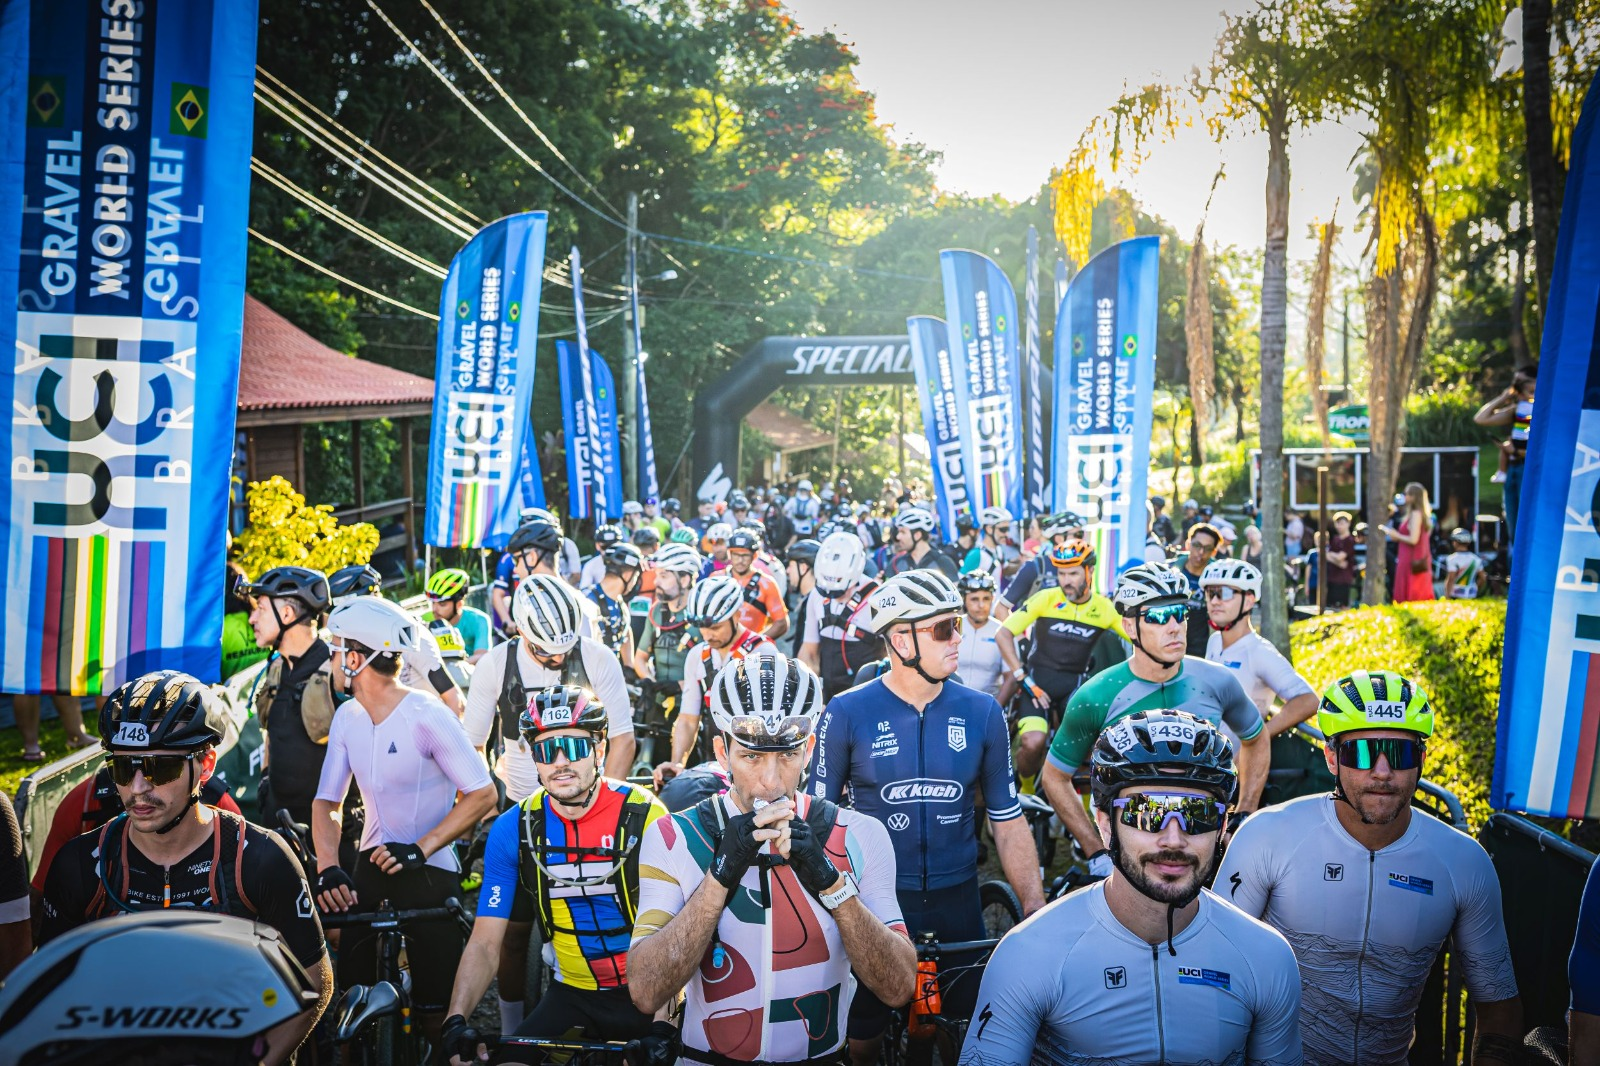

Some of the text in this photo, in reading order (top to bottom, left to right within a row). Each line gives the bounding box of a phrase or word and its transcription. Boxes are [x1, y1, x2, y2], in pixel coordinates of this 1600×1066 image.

[90, 0, 143, 300] WORLD SERIES
[40, 131, 82, 296] GRAVEL
[476, 267, 501, 388] WORLD SERIES
[459, 321, 477, 387] GRAVEL
[1095, 297, 1114, 430] WORLD SERIES
[1076, 357, 1093, 430] GRAVEL
[33, 334, 117, 526] UCI
[452, 402, 485, 478] UCI
[976, 405, 998, 470] UCI
[599, 411, 614, 474] BRASIL
[944, 448, 968, 506] UCI
[881, 596, 897, 608] 242
[1122, 589, 1137, 599] 322
[548, 709, 570, 721] 162
[1374, 704, 1402, 719] 445
[121, 726, 147, 742] 148
[871, 737, 898, 749] NITRIX
[1158, 725, 1194, 740] 436
[194, 865, 212, 875] ONE
[1392, 873, 1408, 883] UCI
[127, 888, 144, 898] BIKE
[173, 891, 190, 899] 1991
[1182, 967, 1201, 977] UCI
[56, 1006, 250, 1030] S-WORKS
